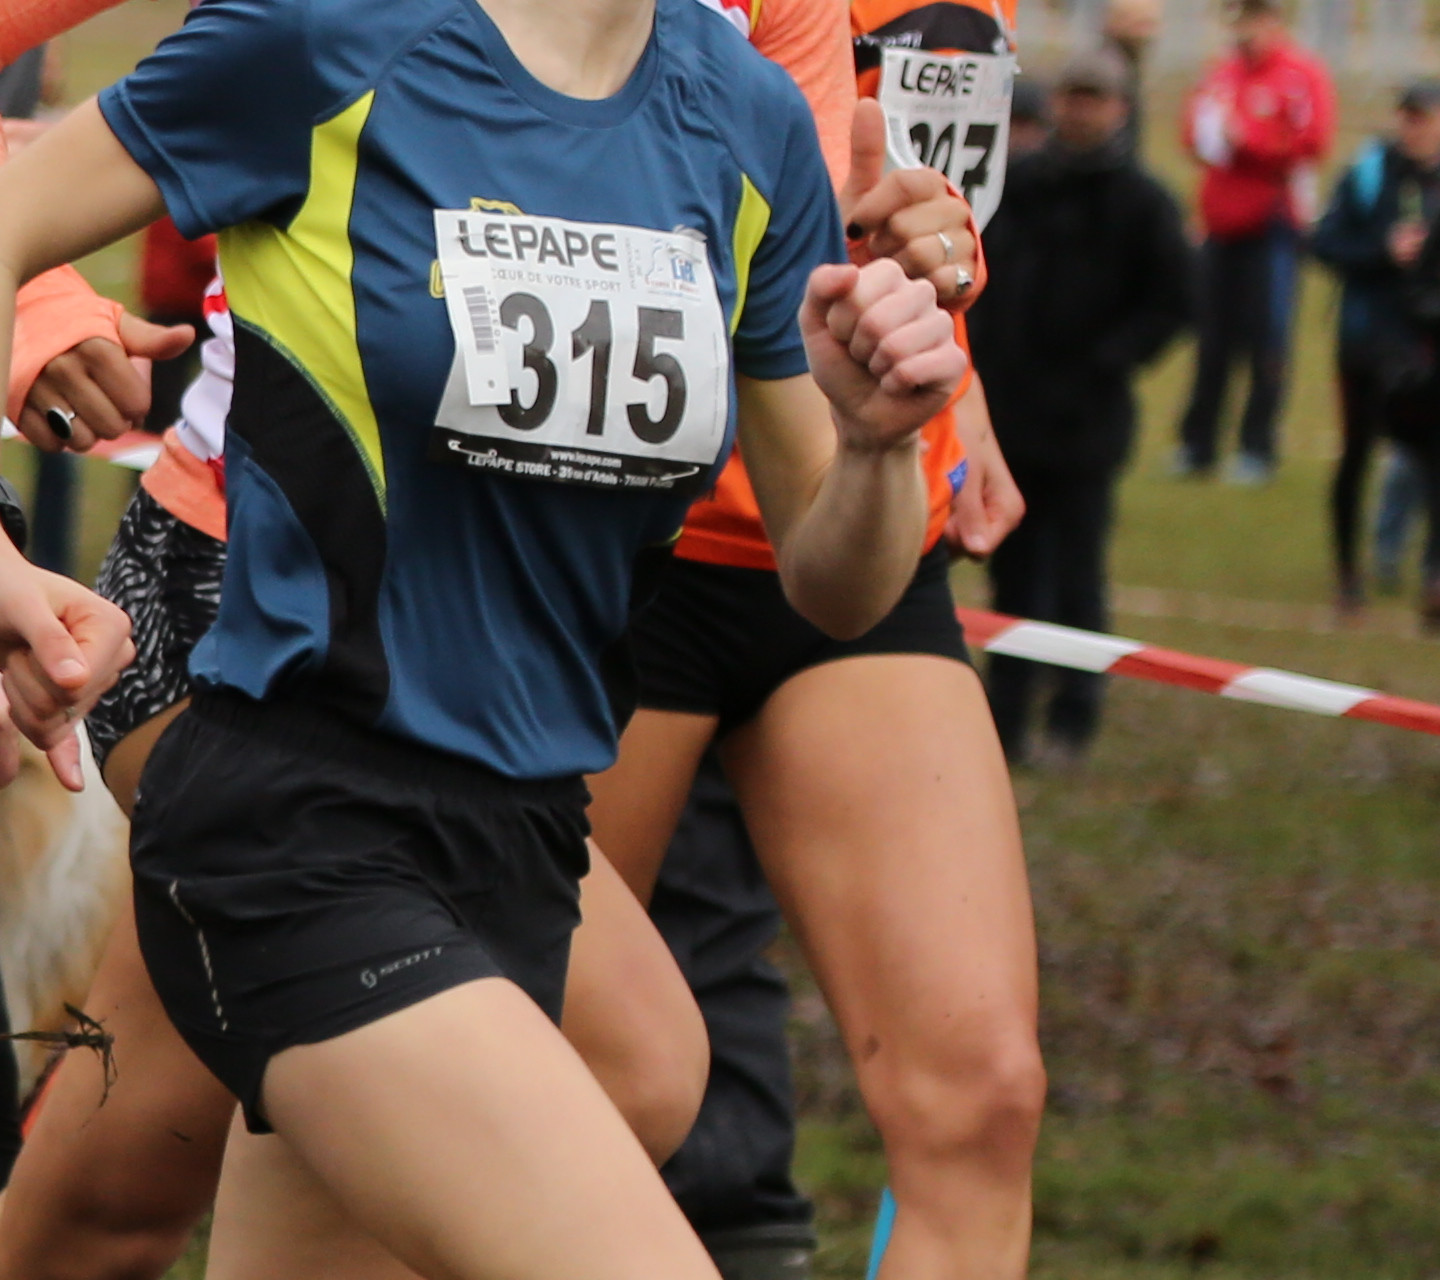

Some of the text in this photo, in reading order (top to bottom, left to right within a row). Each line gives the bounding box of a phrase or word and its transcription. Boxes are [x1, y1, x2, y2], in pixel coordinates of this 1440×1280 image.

[457, 219, 620, 272] LEPAPE
[496, 291, 688, 445] 315
[467, 454, 513, 471] LEPAPE
[515, 463, 552, 477] STORE
[380, 946, 442, 977] SCOTT
